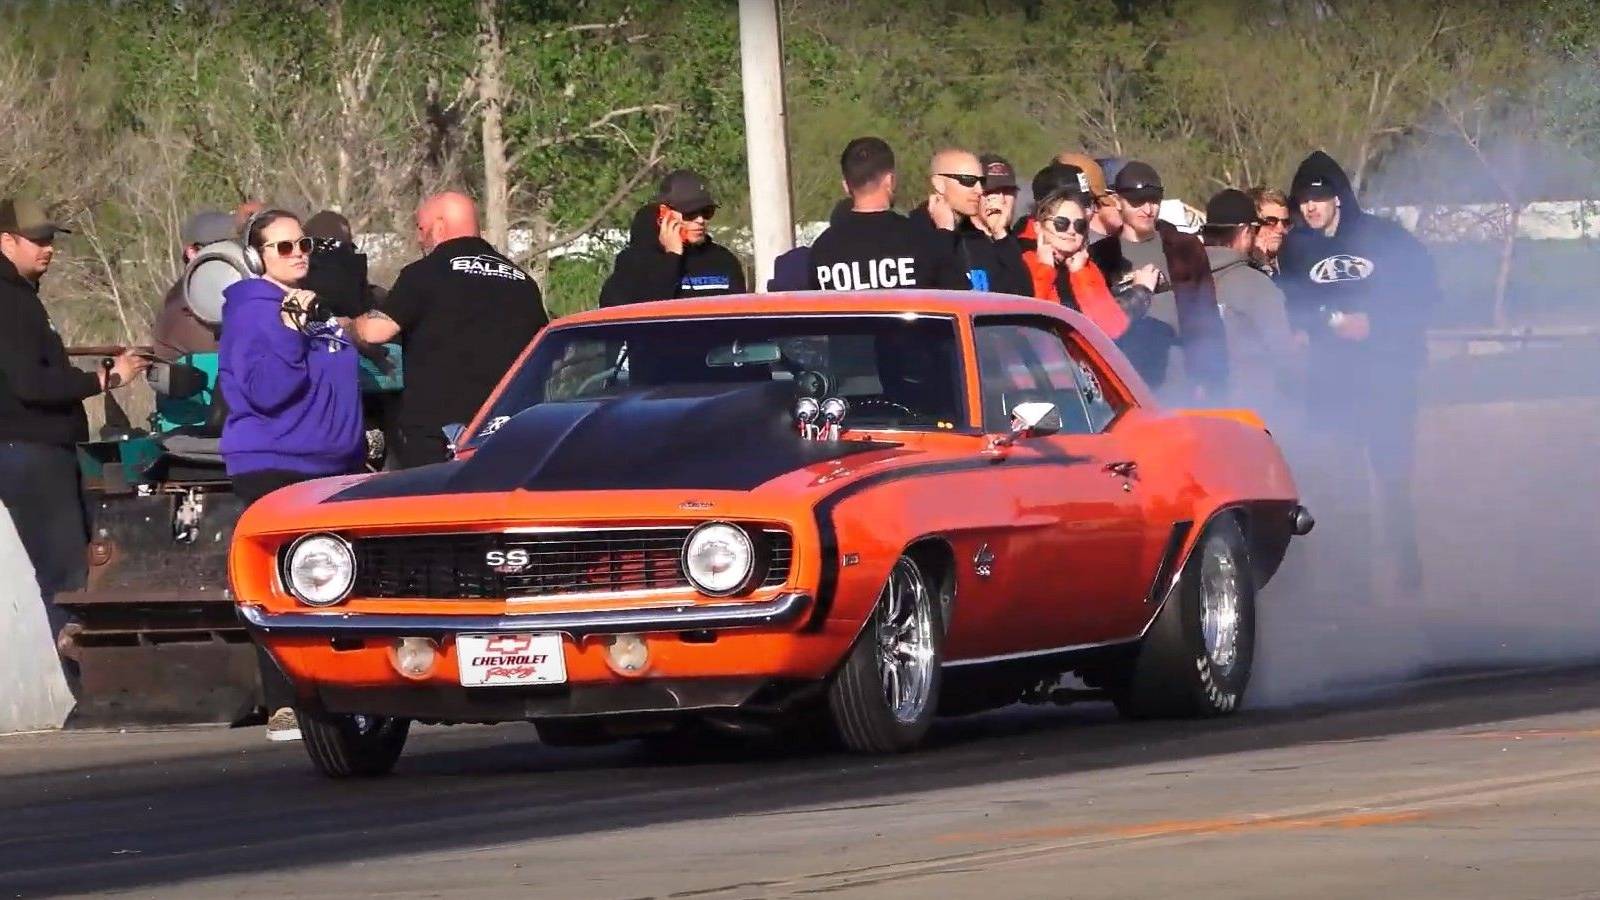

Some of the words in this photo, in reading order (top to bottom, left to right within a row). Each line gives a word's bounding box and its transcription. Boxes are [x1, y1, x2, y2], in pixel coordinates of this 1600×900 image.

[816, 257, 916, 291] POLICE
[486, 549, 528, 566] SS
[472, 654, 549, 667] CHEVROLET
